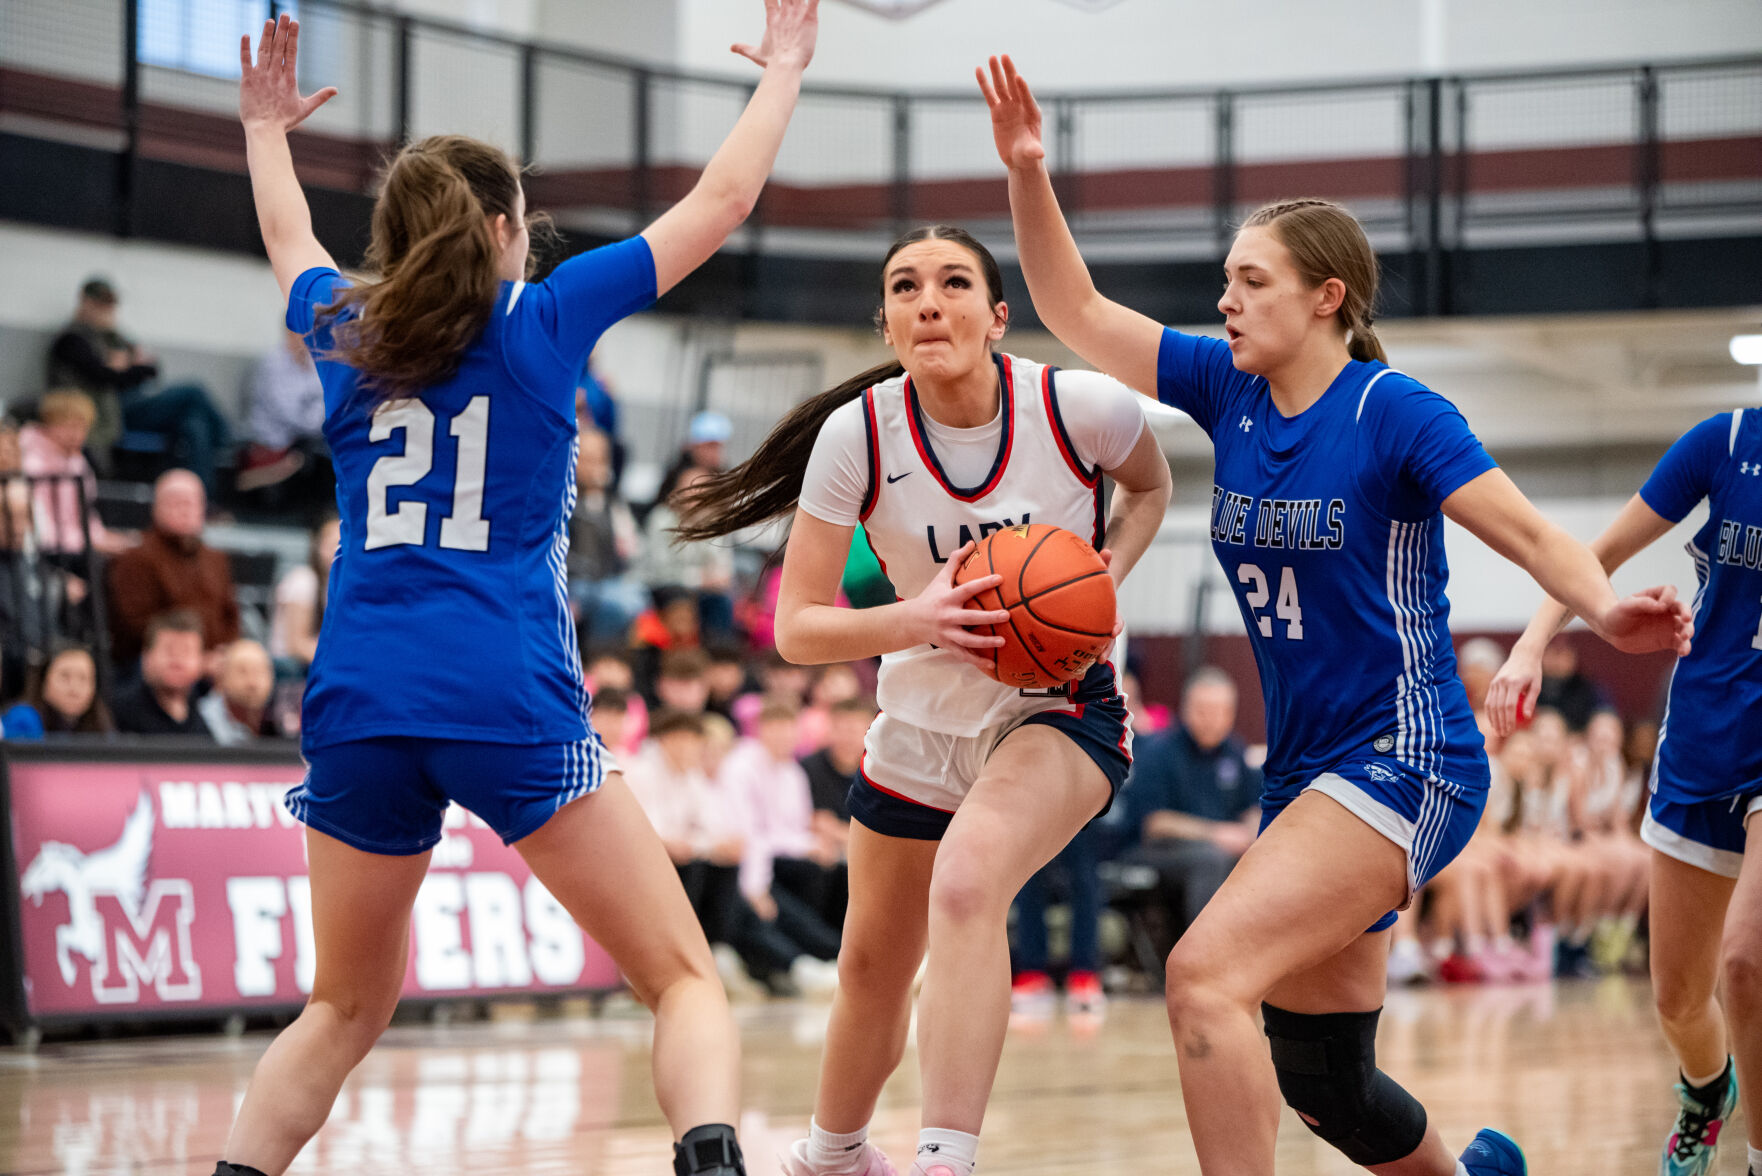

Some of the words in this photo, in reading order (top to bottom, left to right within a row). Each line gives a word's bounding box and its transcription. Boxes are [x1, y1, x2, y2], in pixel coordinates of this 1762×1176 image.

[364, 395, 491, 551] 21
[1211, 484, 1254, 546] LUE
[1254, 498, 1346, 550] DEVILS
[1717, 520, 1762, 571] BLU
[1237, 562, 1304, 641] 24
